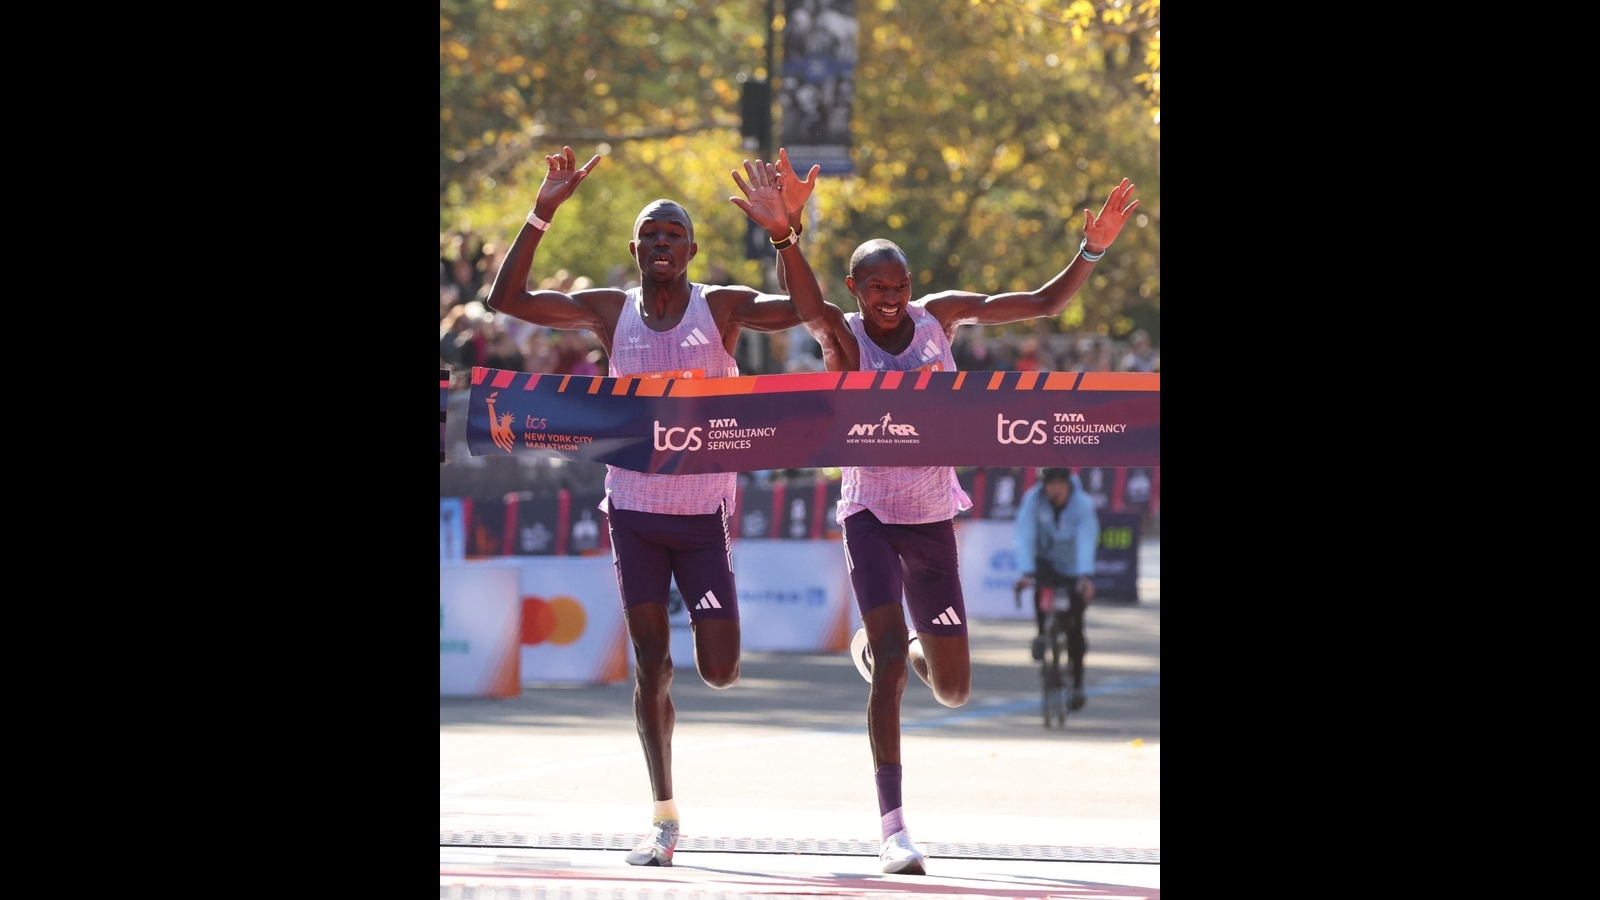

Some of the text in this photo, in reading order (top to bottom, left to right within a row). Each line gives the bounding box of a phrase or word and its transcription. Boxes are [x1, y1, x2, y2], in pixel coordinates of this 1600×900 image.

[525, 414, 547, 430] tcs
[708, 418, 738, 428] TATA
[1053, 413, 1086, 422] TATA
[708, 427, 777, 440] CONSULTANCY
[997, 412, 1048, 445] tcs
[1053, 424, 1127, 434] CONSULTANCY
[524, 432, 593, 444] NEW YORK CITY
[653, 420, 703, 451] tcs
[1053, 435, 1100, 445] SERVICES
[525, 441, 578, 451] MARATHON
[707, 439, 752, 451] SERVICES
